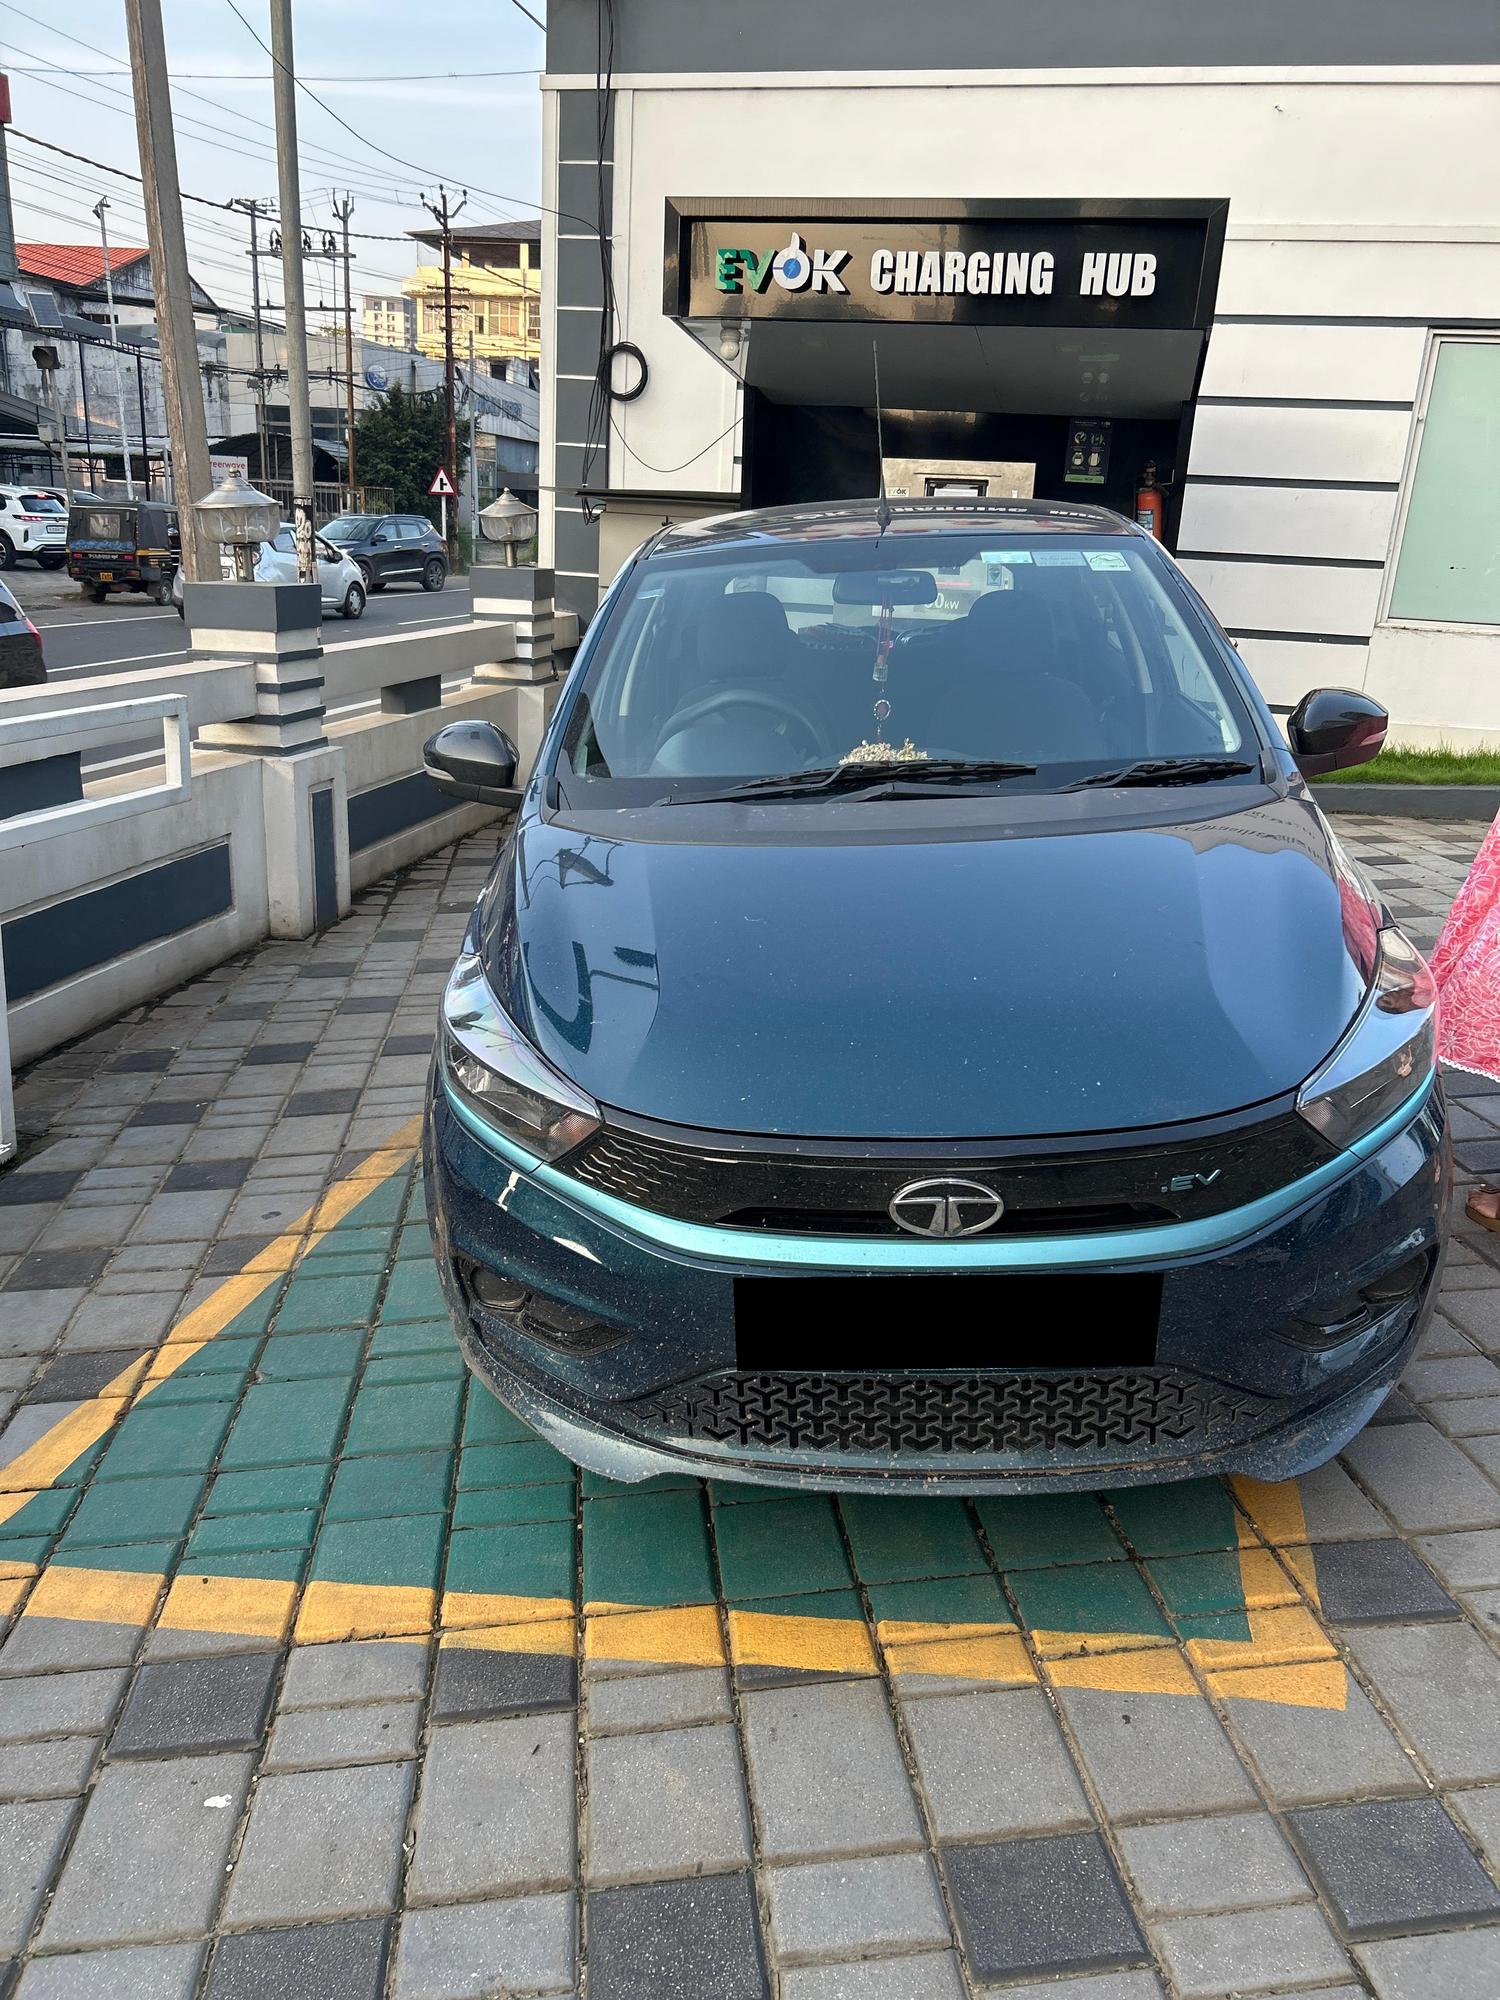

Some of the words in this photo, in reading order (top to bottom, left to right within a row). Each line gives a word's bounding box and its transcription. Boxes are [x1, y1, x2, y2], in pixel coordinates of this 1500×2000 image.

[715, 232, 849, 291] EVOK
[870, 249, 1055, 295] CHARGING
[1079, 252, 1157, 296] HUB
[924, 592, 960, 610] 0kW
